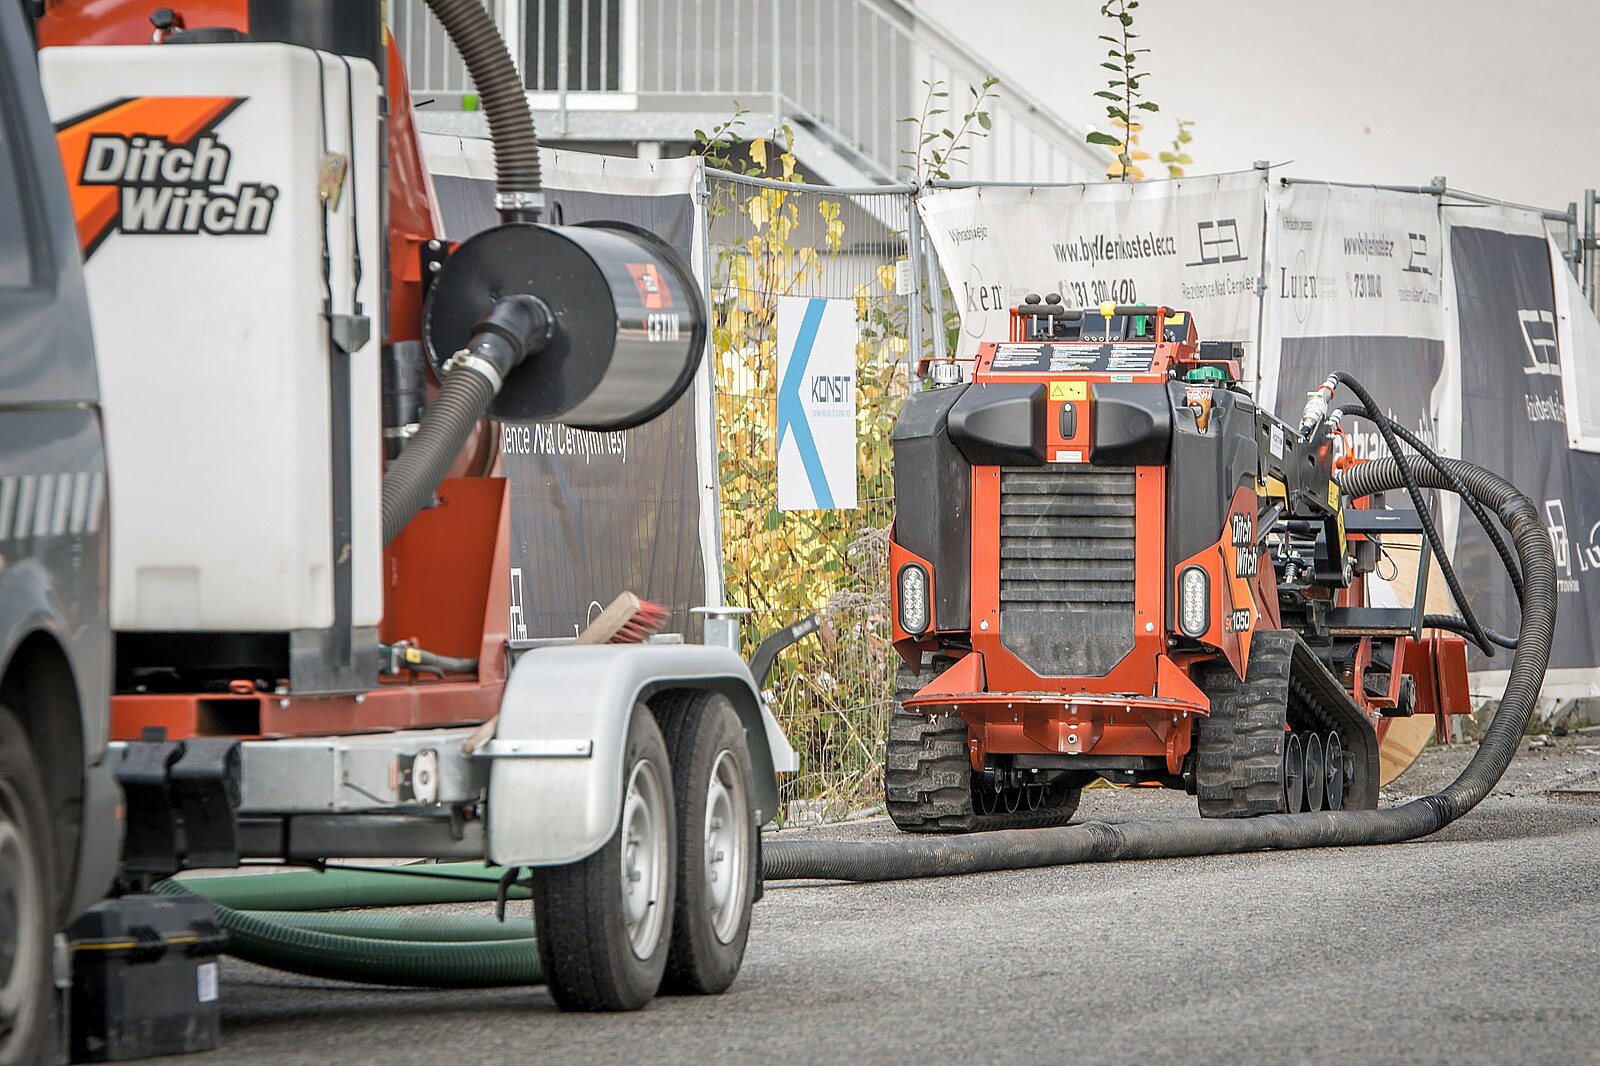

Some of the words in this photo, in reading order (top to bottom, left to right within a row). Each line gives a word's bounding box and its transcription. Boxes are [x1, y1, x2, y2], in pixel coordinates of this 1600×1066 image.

[82, 136, 229, 183] Ditch
[121, 186, 273, 231] Witch
[811, 375, 851, 402] KONSIT
[1232, 514, 1252, 544] Ditch
[1236, 546, 1257, 576] Witch
